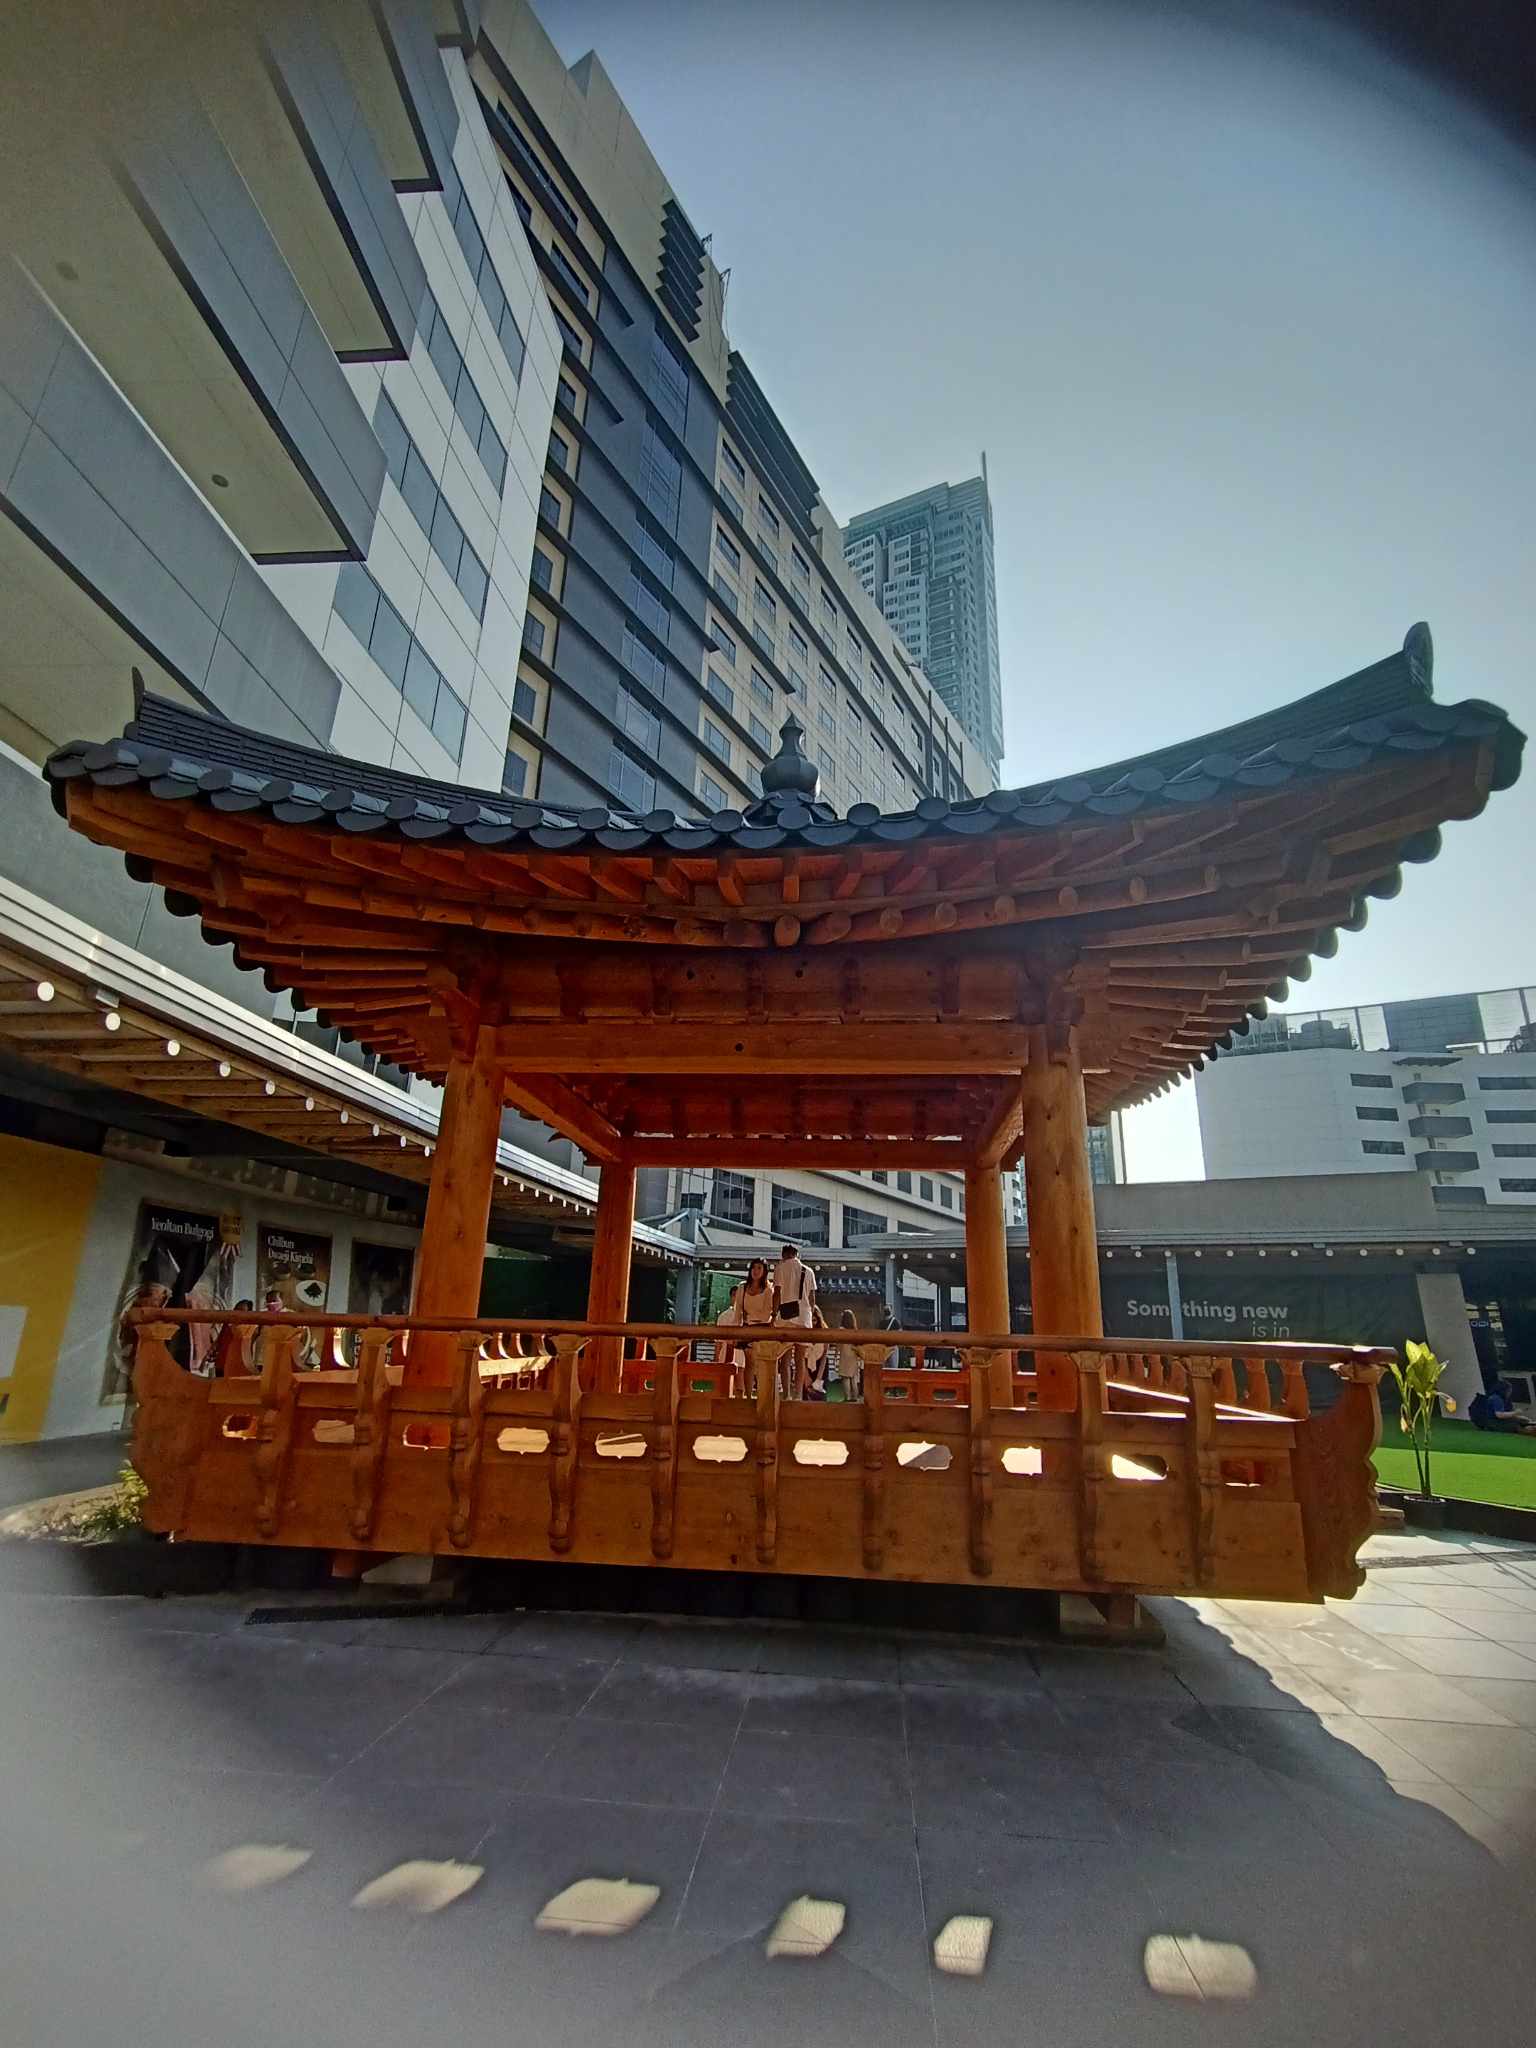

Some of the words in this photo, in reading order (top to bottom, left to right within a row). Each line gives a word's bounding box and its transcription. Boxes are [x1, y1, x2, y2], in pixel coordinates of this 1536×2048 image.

[1127, 1300, 1236, 1323] Somthing
[1242, 1306, 1289, 1319] new
[1252, 1321, 1267, 1338] is
[1273, 1321, 1290, 1338] in
